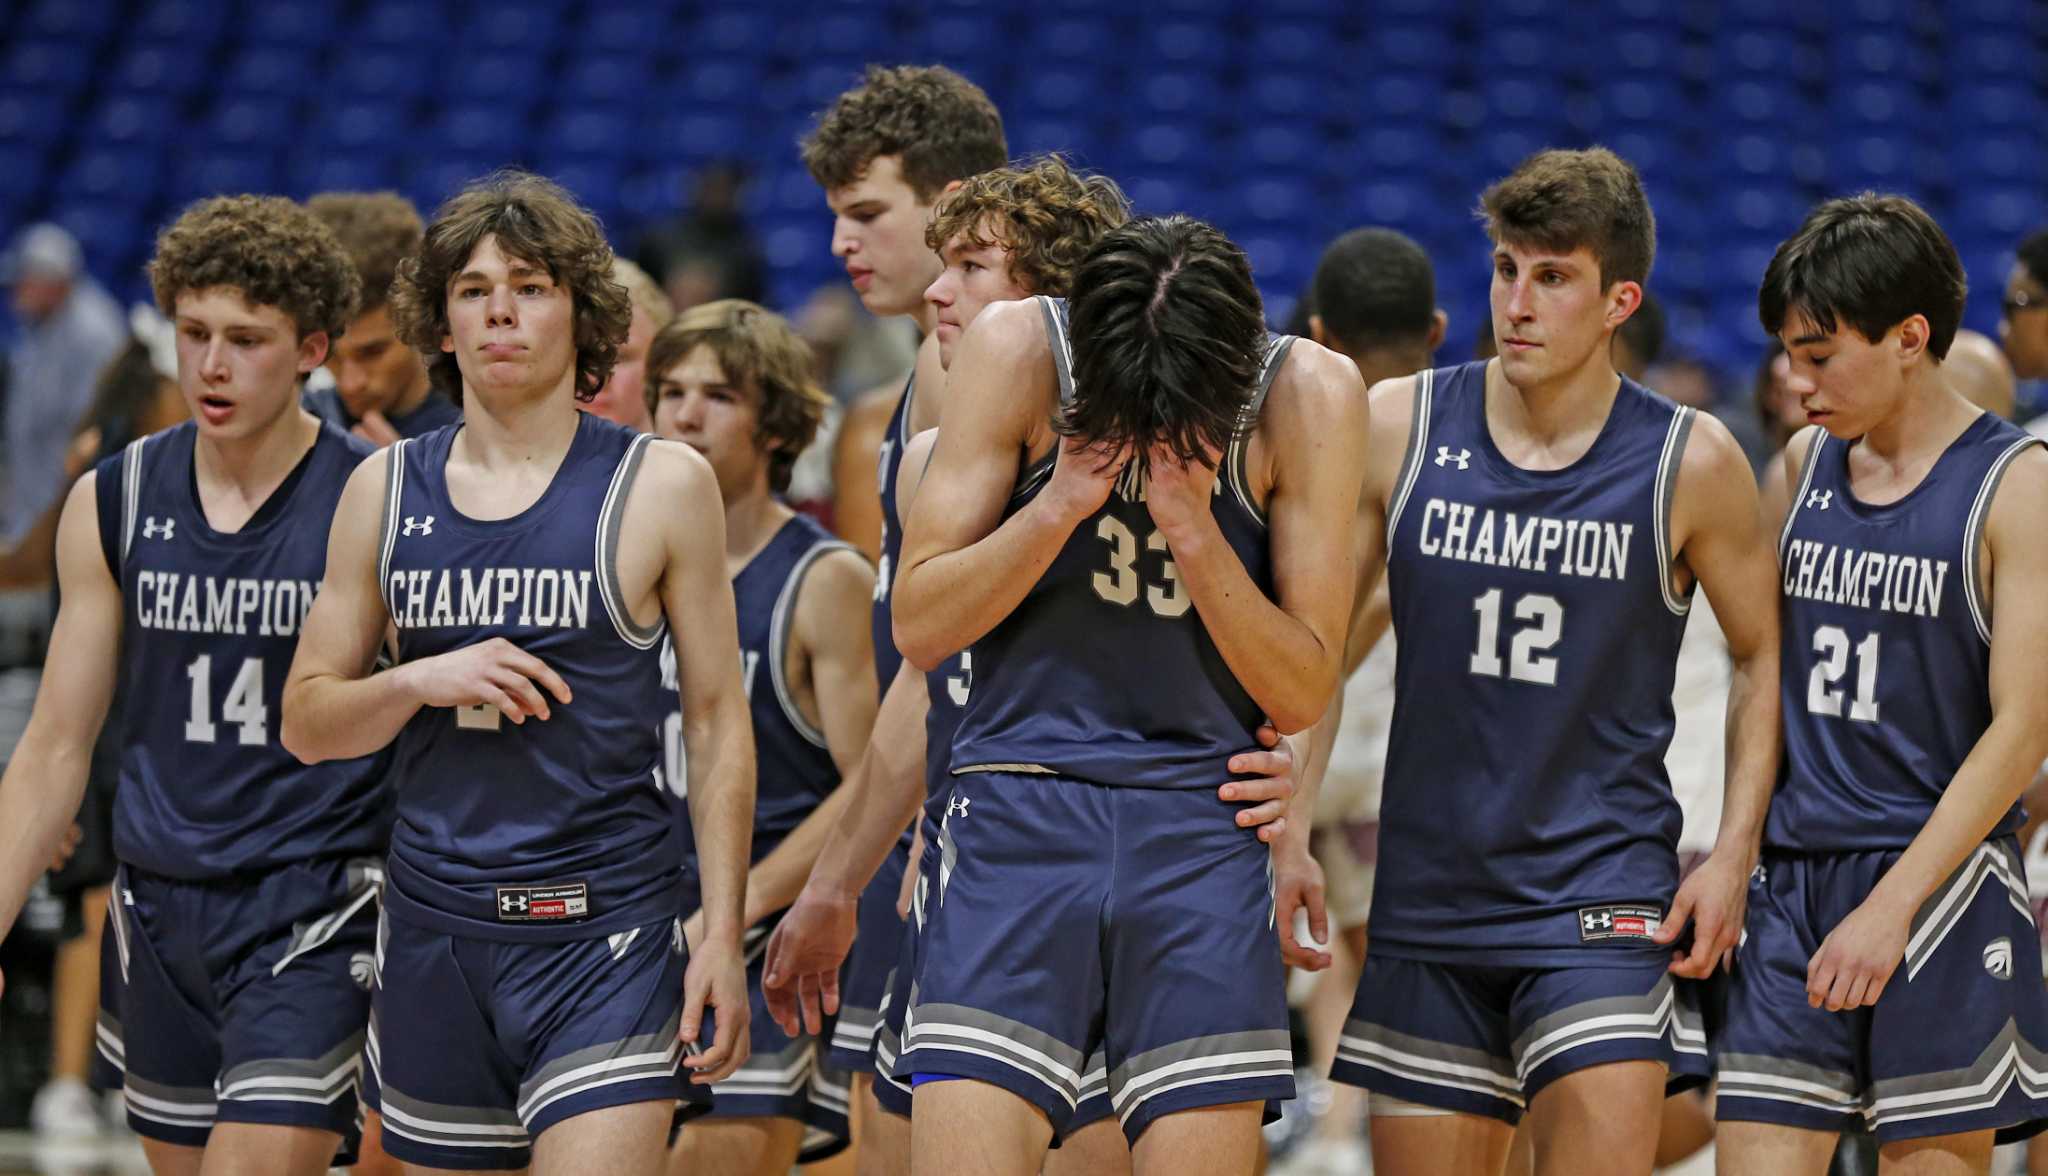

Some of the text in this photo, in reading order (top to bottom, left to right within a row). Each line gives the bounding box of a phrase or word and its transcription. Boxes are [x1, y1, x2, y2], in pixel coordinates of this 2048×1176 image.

[1092, 514, 1191, 617] 33
[1419, 498, 1633, 580] CHAMPION
[1784, 539, 1949, 617] CHAMPION
[390, 568, 592, 629] CHAMPION
[1470, 588, 1564, 686] 12
[185, 654, 268, 746] 14
[1807, 625, 1880, 722] 21
